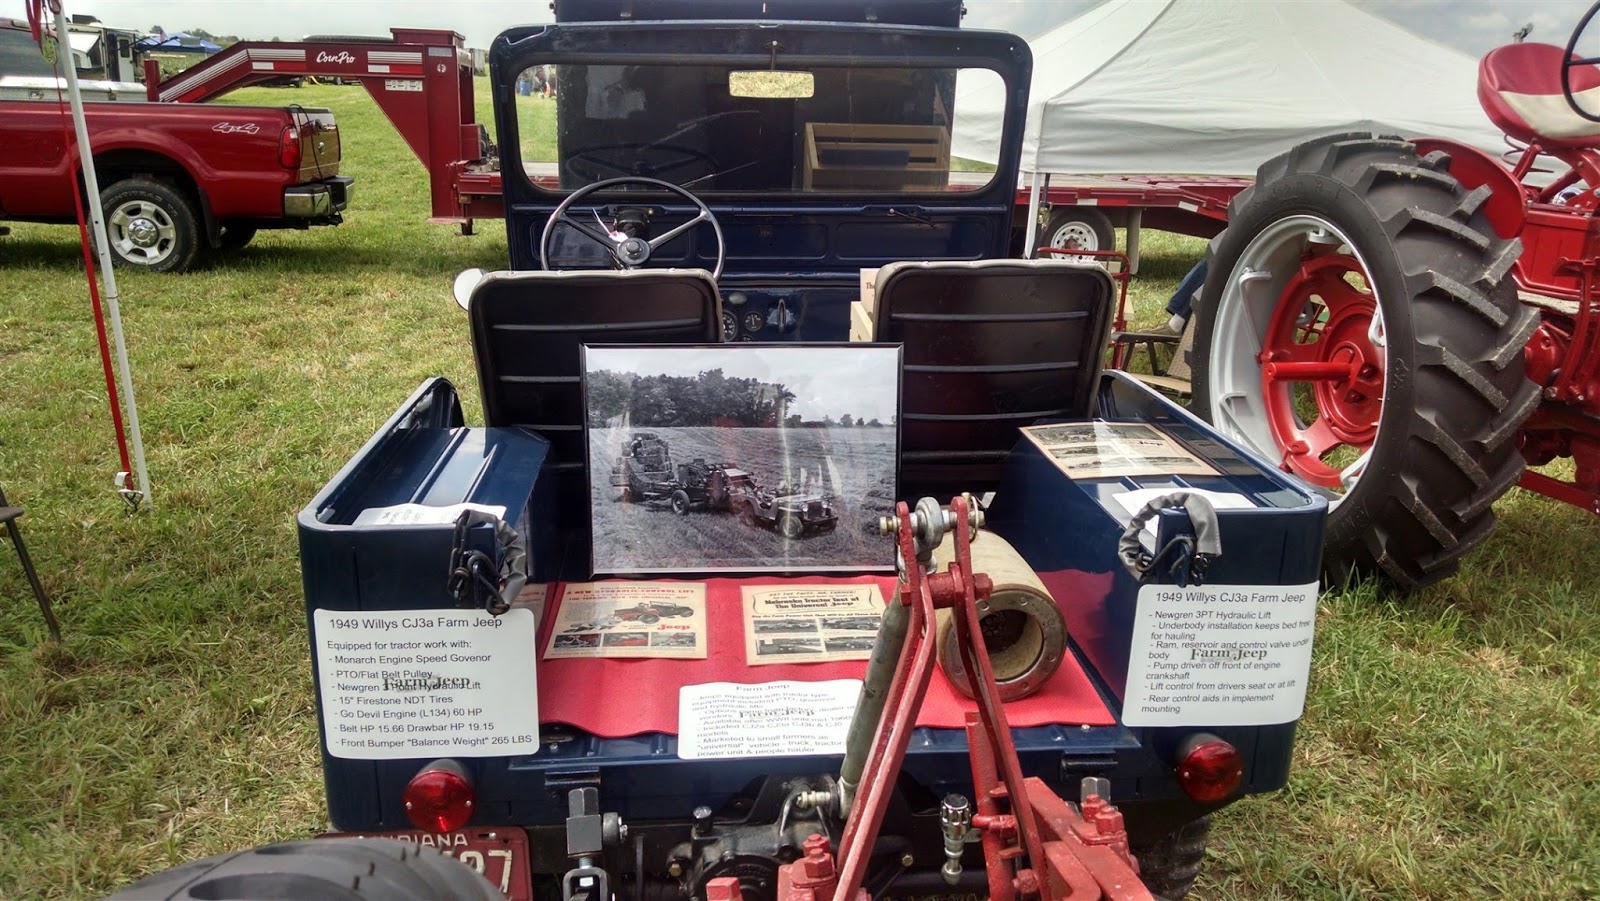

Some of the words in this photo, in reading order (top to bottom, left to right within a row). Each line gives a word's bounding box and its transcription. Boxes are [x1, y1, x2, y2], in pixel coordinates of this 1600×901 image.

[316, 51, 356, 64] CornPro
[212, 123, 260, 134] 4x4
[1156, 593, 1182, 602] 1949
[1186, 593, 1216, 604] Willys
[1220, 593, 1248, 602] CJ3a
[1251, 593, 1278, 602] Farm
[1282, 593, 1305, 604] Jeep
[1155, 611, 1193, 619] Newgren
[1216, 611, 1256, 620] Hydraulic
[329, 619, 358, 628] 1949
[363, 619, 398, 630] Willys
[402, 618, 433, 628] CJ3a
[438, 618, 468, 627] Farm
[473, 617, 502, 628] Jeep
[1159, 622, 1205, 630] Underbody
[1255, 622, 1279, 630] keeps
[1165, 633, 1195, 641] hauling
[327, 640, 371, 650] Equipped
[375, 641, 386, 649] for
[390, 640, 421, 649] tractor
[424, 640, 447, 648] work
[335, 655, 376, 664] Monarch
[380, 655, 413, 665] Engine
[416, 654, 447, 664] Speed
[450, 654, 491, 663] Govenor
[1149, 652, 1169, 660] body
[1190, 649, 1230, 660] Farm
[1233, 649, 1267, 661] Jeep
[1153, 662, 1178, 670] Pump
[337, 670, 378, 679] PTO/Flat
[382, 670, 400, 678] Belt
[404, 669, 433, 680] Pulley
[338, 683, 379, 693] Newgren
[390, 683, 416, 691] Point
[466, 681, 481, 690] Lift
[339, 696, 353, 704] 15"
[357, 696, 401, 704] Firestone
[404, 695, 425, 704] NDT
[1232, 694, 1274, 703] implement
[357, 709, 380, 718] Devil
[383, 709, 416, 720] Engine
[420, 709, 450, 718] (L134)
[453, 708, 464, 717] 60
[340, 724, 357, 732] Belt
[378, 724, 404, 732] 15.66
[407, 723, 447, 732] Drawbar
[341, 738, 364, 747] Front
[368, 739, 404, 748] Bumper
[408, 738, 449, 746] "Balance
[452, 737, 489, 748] Weight"
[491, 736, 509, 745] 265
[512, 735, 532, 744] LBS
[381, 834, 468, 846] DIANA
